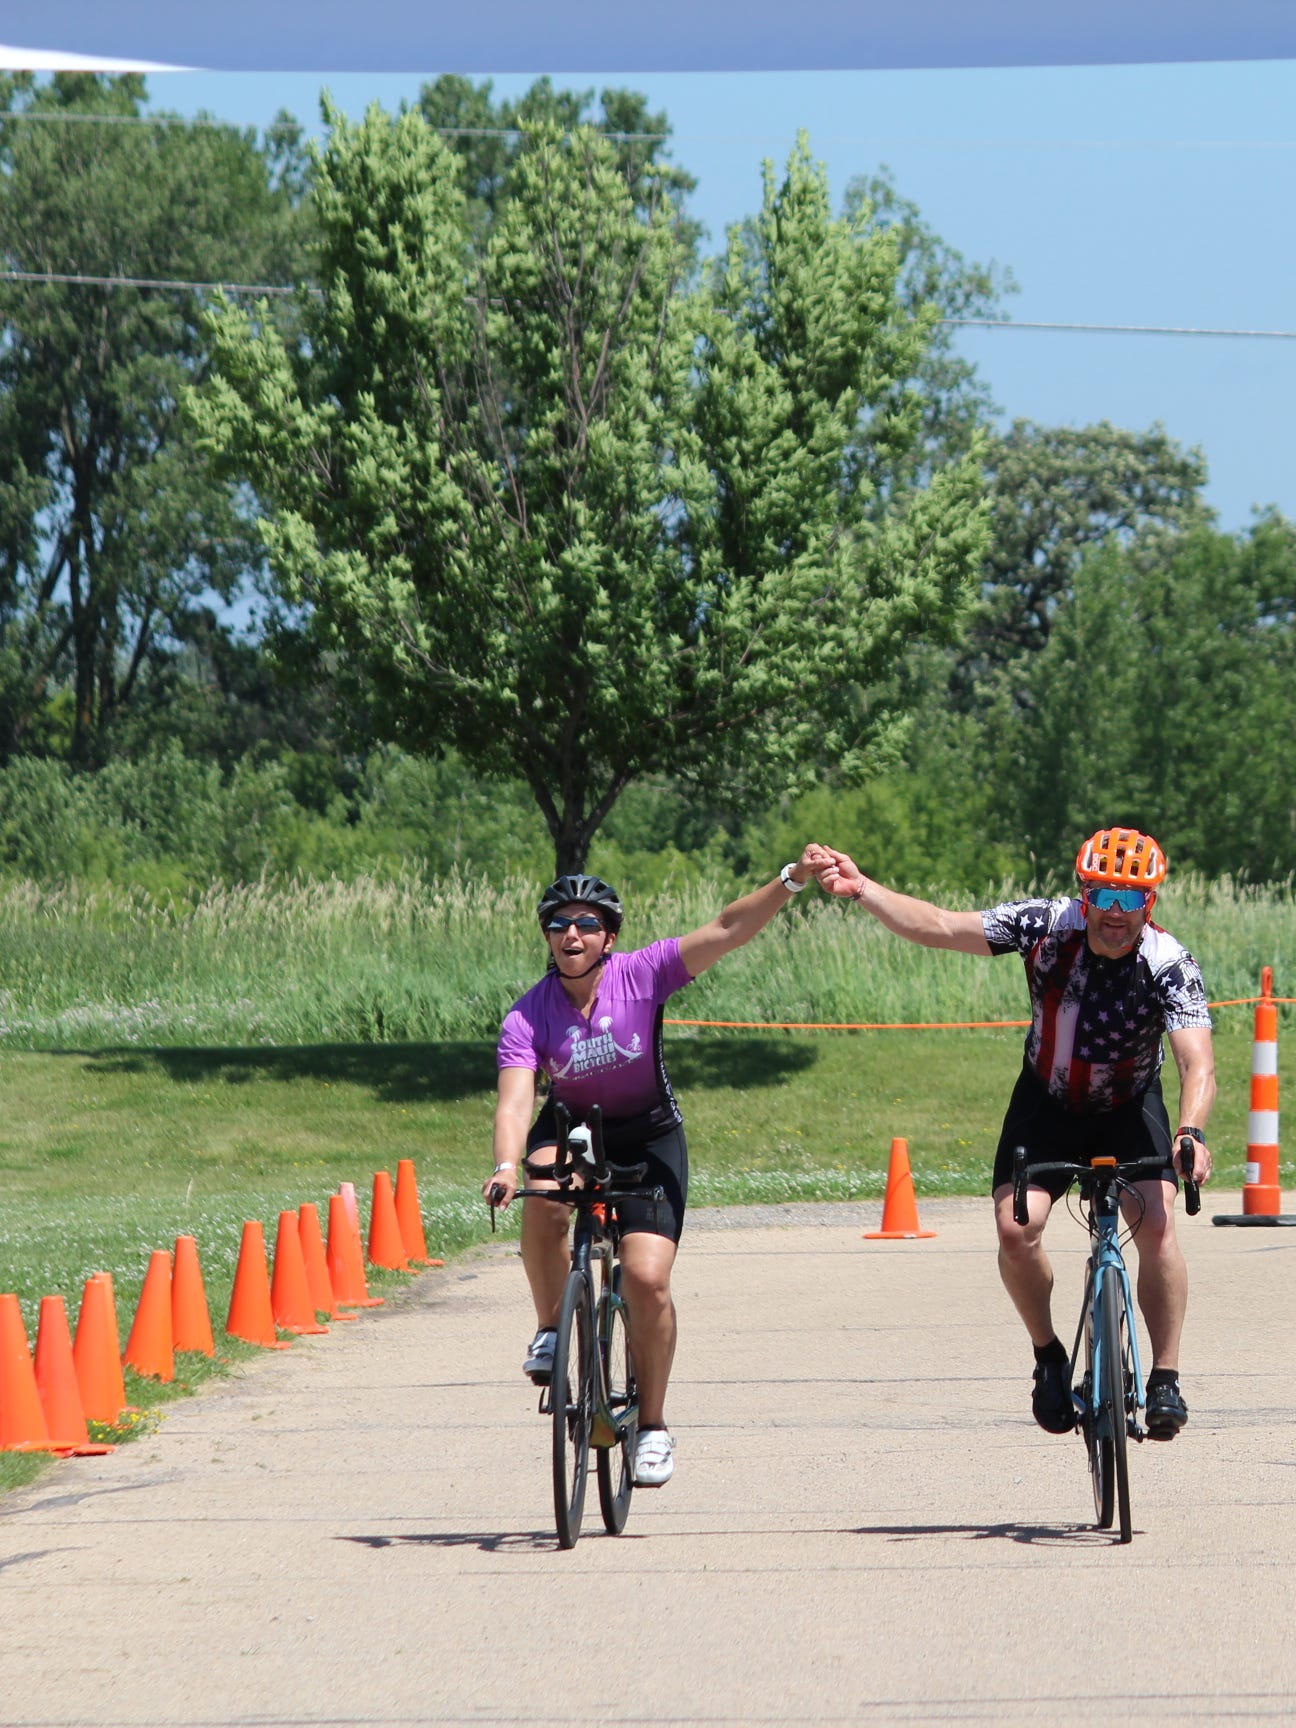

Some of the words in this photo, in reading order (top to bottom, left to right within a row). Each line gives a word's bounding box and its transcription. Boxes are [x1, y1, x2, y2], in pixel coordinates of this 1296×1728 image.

[571, 1032, 613, 1053] SOUTH
[572, 1042, 615, 1063] MAUI
[574, 1052, 617, 1073] BICYCLES
